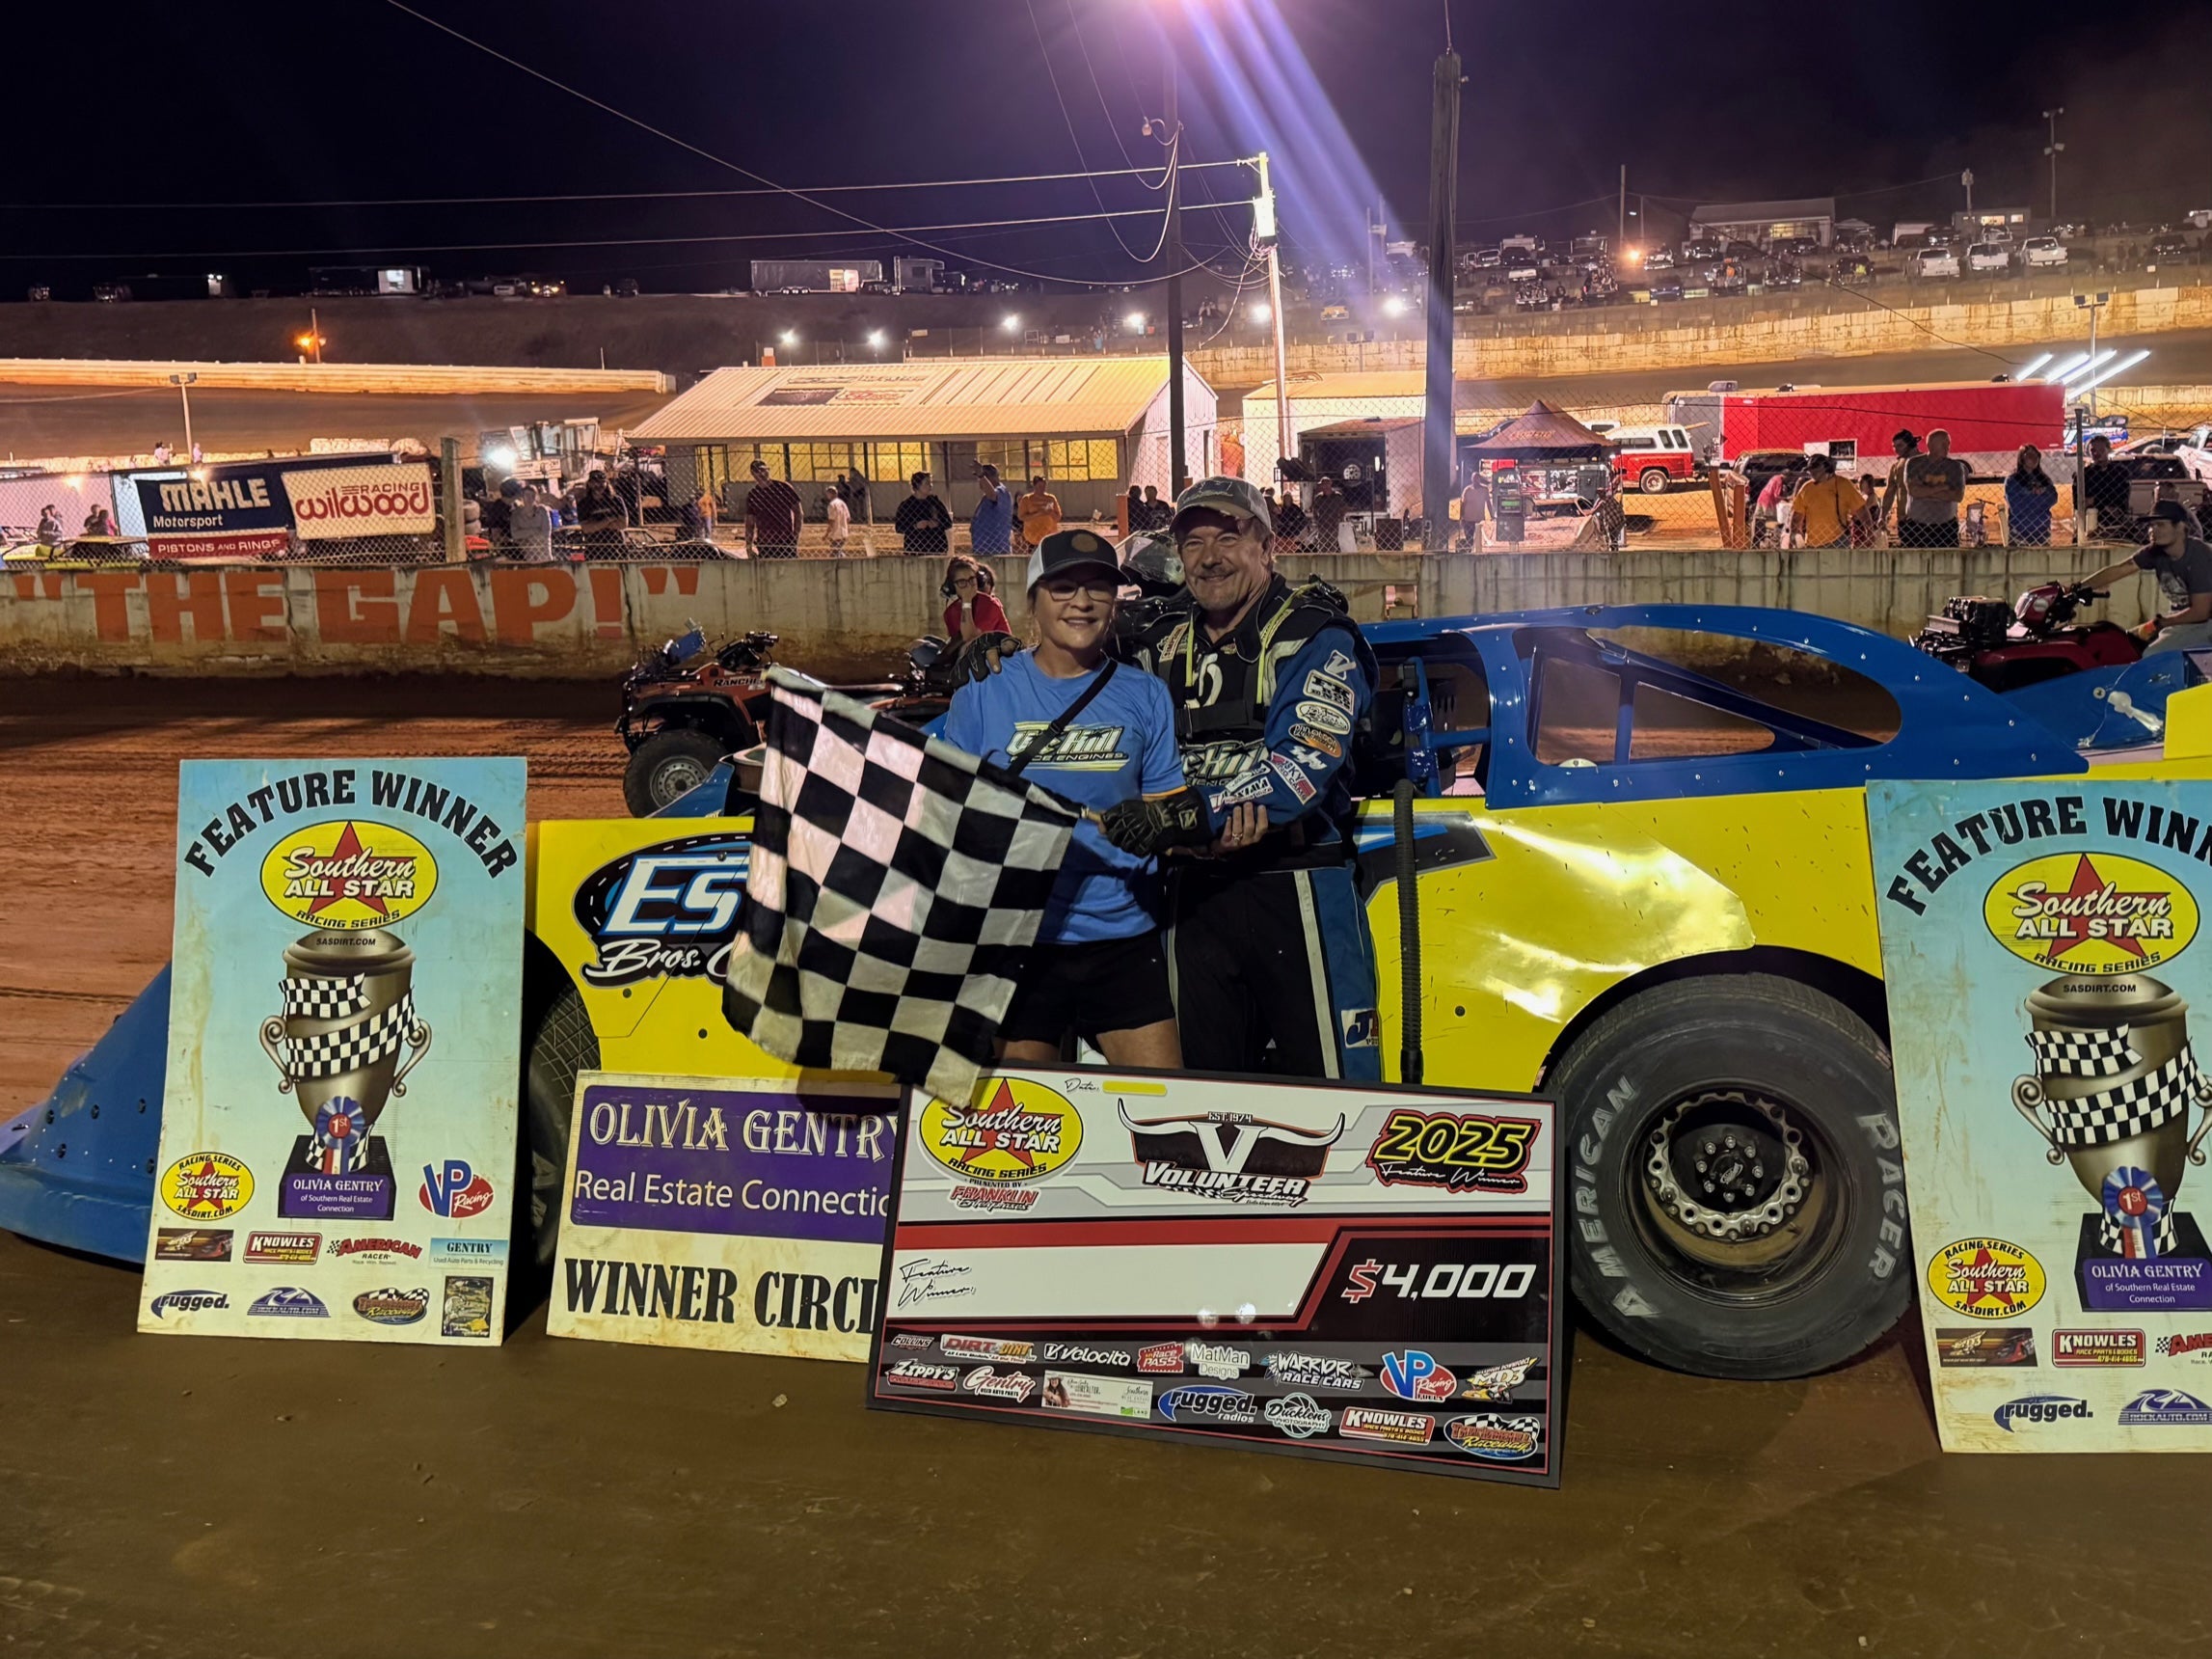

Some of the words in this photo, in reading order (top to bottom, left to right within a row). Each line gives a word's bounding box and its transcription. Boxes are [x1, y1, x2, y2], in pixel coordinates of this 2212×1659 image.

[159, 478, 270, 512] MAHLE
[359, 483, 420, 495] RACING
[295, 482, 429, 521] wilwood
[153, 514, 223, 529] Motorsport
[158, 543, 214, 554] PISTONS
[184, 769, 356, 878] FEATURE
[371, 770, 518, 879] WINNER
[284, 846, 416, 880] Southern
[1886, 797, 2088, 916] FEATURE
[284, 879, 335, 898] ALL
[342, 879, 415, 899] STAR
[2012, 882, 2171, 916] Southern
[296, 910, 346, 928] RACING
[351, 910, 401, 928] SERIES
[2016, 917, 2077, 938] ALL
[2088, 918, 2172, 938] STAR
[315, 938, 376, 946] SASDIRT.COM
[585, 938, 701, 978] Bros.
[2034, 953, 2096, 973] RACING
[2102, 952, 2161, 973] SERIES
[2063, 984, 2137, 993] SASDIRT.COM
[589, 1098, 729, 1152] OLIVIA
[941, 1102, 1063, 1133] Southern
[940, 1129, 986, 1148] ALL
[995, 1131, 1061, 1155] STAR
[1374, 1115, 1534, 1170] 2025
[178, 1155, 211, 1172] RACING
[213, 1155, 243, 1172] SERIES
[948, 1157, 996, 1178] RACING
[998, 1162, 1047, 1179] SERIES
[176, 1170, 239, 1188] Southern
[293, 1178, 332, 1191] OLIVIA
[335, 1179, 384, 1192] GENTRY
[422, 1159, 472, 1218] VP
[969, 1179, 1011, 1187] PRESENTED
[1145, 1161, 1308, 1196] VOLUNTEER
[174, 1186, 201, 1199] ALL
[202, 1186, 239, 1200] STAR
[309, 1195, 337, 1204] Southern
[338, 1195, 351, 1204] Real
[353, 1195, 373, 1204] Estate
[575, 1170, 636, 1203] Real
[644, 1174, 733, 1209] Estate
[951, 1185, 1039, 1205] FRANKLIN
[1573, 1075, 1663, 1318] AMERICAN
[317, 1204, 355, 1213] Connection
[454, 1190, 495, 1210] Racing
[176, 1204, 233, 1219] SASDIRT.COM
[251, 1236, 314, 1252] KNOWLES
[337, 1237, 423, 1260] AMERICAN
[446, 1241, 493, 1253] GENTRY
[1945, 1240, 1983, 1260] RACING
[1986, 1240, 2025, 1260] SERIES
[1946, 1259, 2026, 1279] Southern
[2091, 1265, 2140, 1278] OLIVIA
[2145, 1263, 2203, 1278] GENTRY
[565, 1258, 738, 1323] WINNER
[1341, 1258, 1537, 1304] $4,000
[1948, 1280, 1979, 1293] ALL
[1983, 1280, 2029, 1293] STAR
[2115, 1283, 2151, 1292] Southern
[2153, 1283, 2170, 1292] Real
[2172, 1283, 2196, 1292] Estate
[159, 1293, 229, 1313] rugged.
[1953, 1300, 2027, 1317] SASDIRT.COM
[2129, 1294, 2175, 1304] Connection
[892, 1336, 931, 1346] COLLINS
[945, 1338, 995, 1352] DIRT
[2060, 1335, 2137, 1353] KNOWLES
[1144, 1357, 1178, 1368] PASS
[1192, 1344, 1250, 1366] MatMan
[1278, 1353, 1354, 1376] WARRIOR
[1200, 1363, 1239, 1377] Designs
[1382, 1349, 1435, 1400] VP
[964, 1367, 1037, 1401] Gentry
[1281, 1373, 1319, 1386] RACE
[1322, 1375, 1363, 1390] CARS
[1416, 1377, 1454, 1395] Racing
[1169, 1389, 1257, 1416] rugged.
[2004, 1400, 2093, 1422] rugged.
[1218, 1412, 1254, 1424] radios
[1346, 1409, 1427, 1429] KNOWLES
[2129, 1413, 2208, 1422] ROCKAUTO.COM
[1463, 1436, 1533, 1453] Raceway
